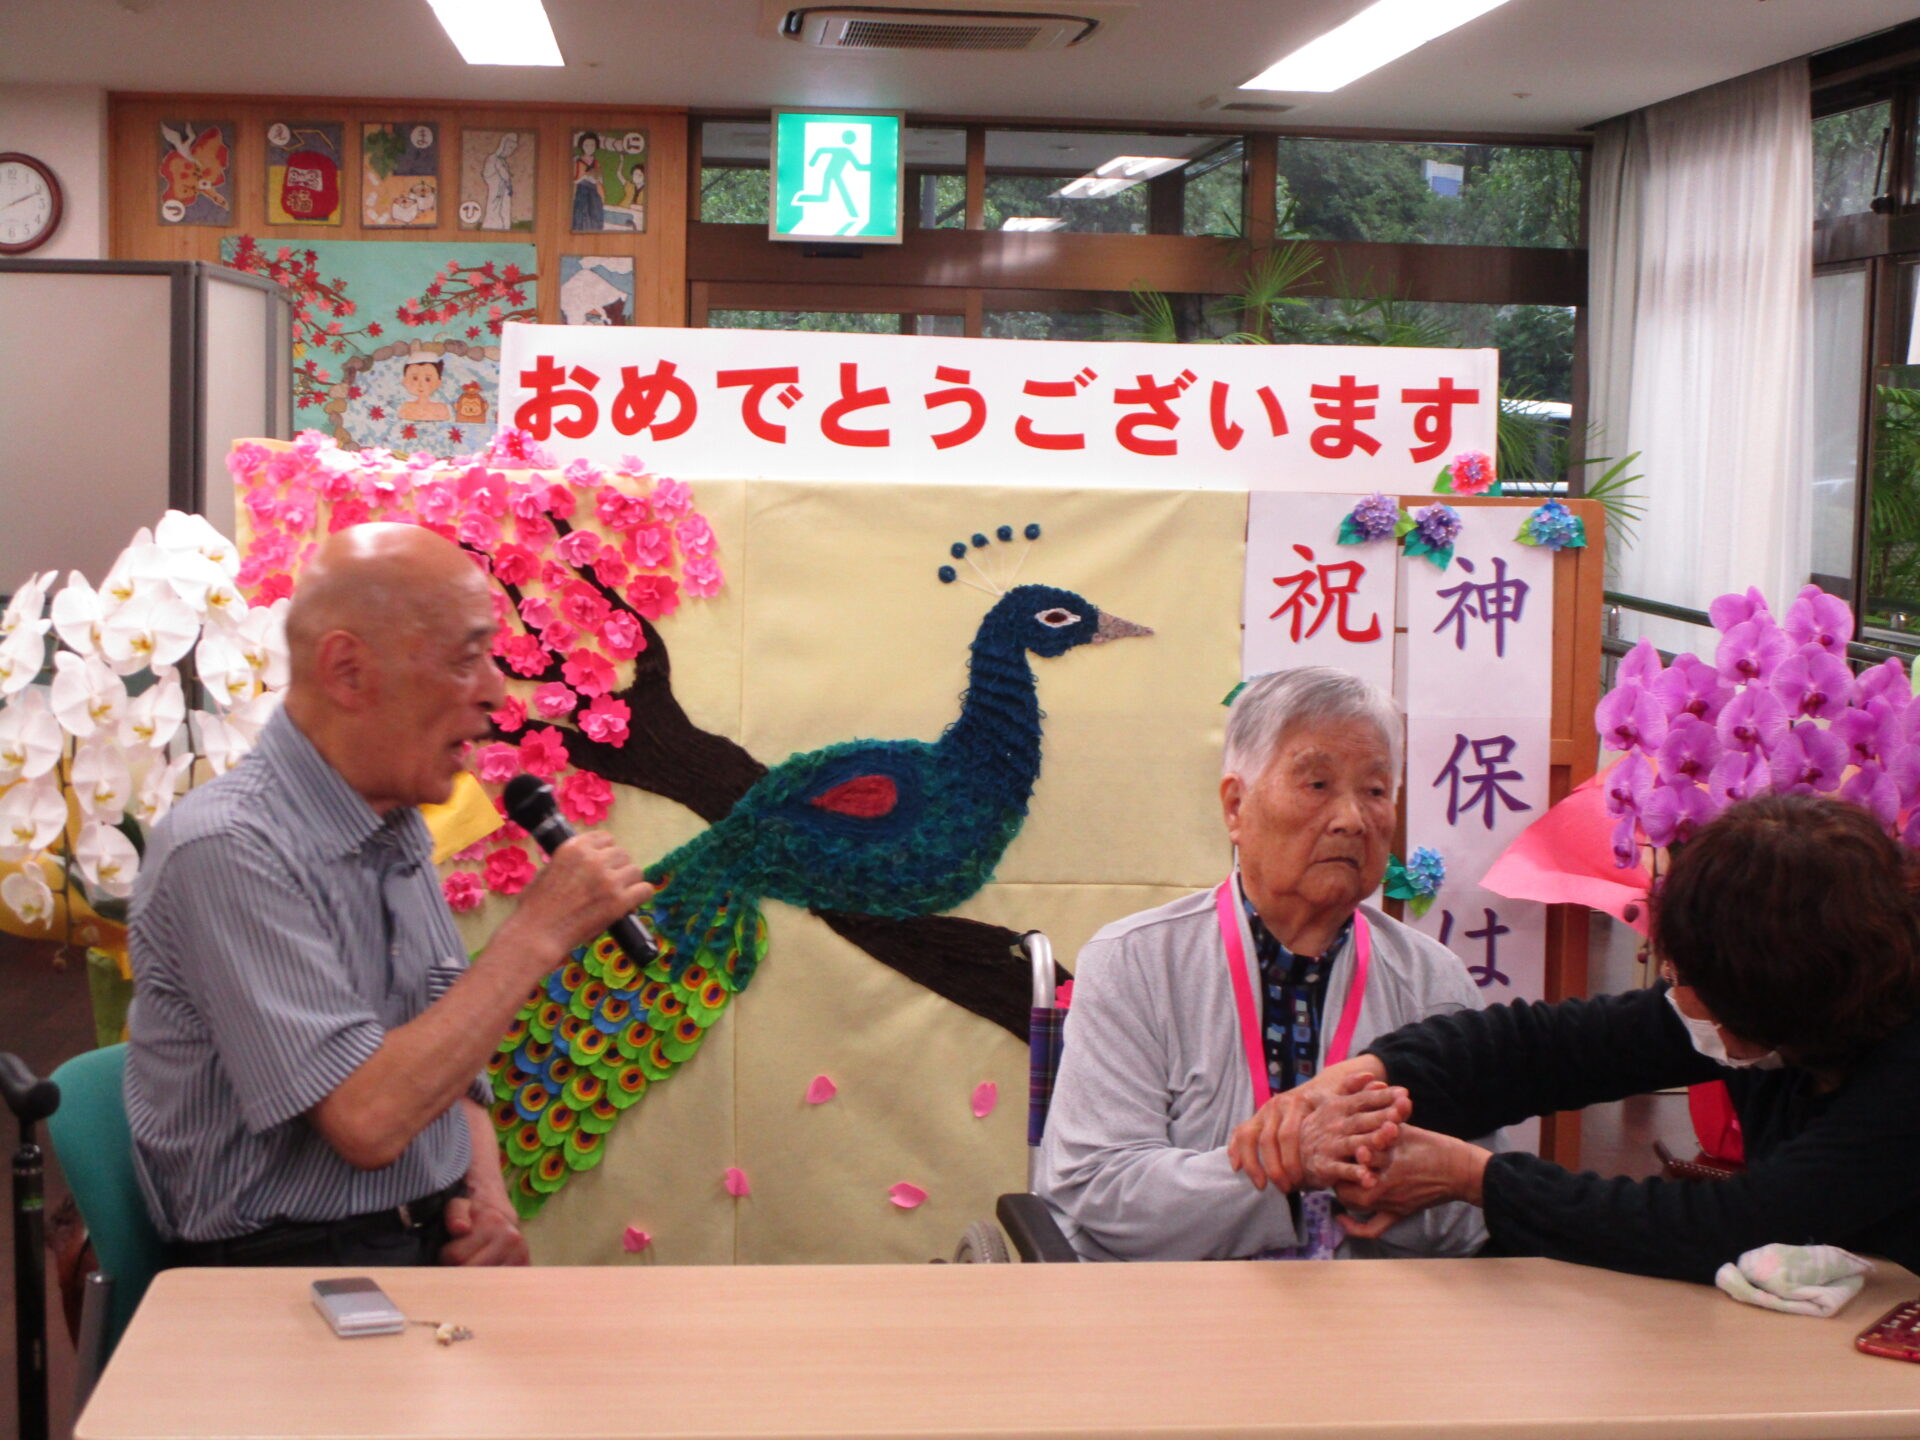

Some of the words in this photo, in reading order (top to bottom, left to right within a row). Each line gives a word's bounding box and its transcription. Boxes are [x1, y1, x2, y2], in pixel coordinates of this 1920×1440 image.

[513, 355, 1481, 464] おめでとうございます
[1269, 543, 1382, 644] 祝
